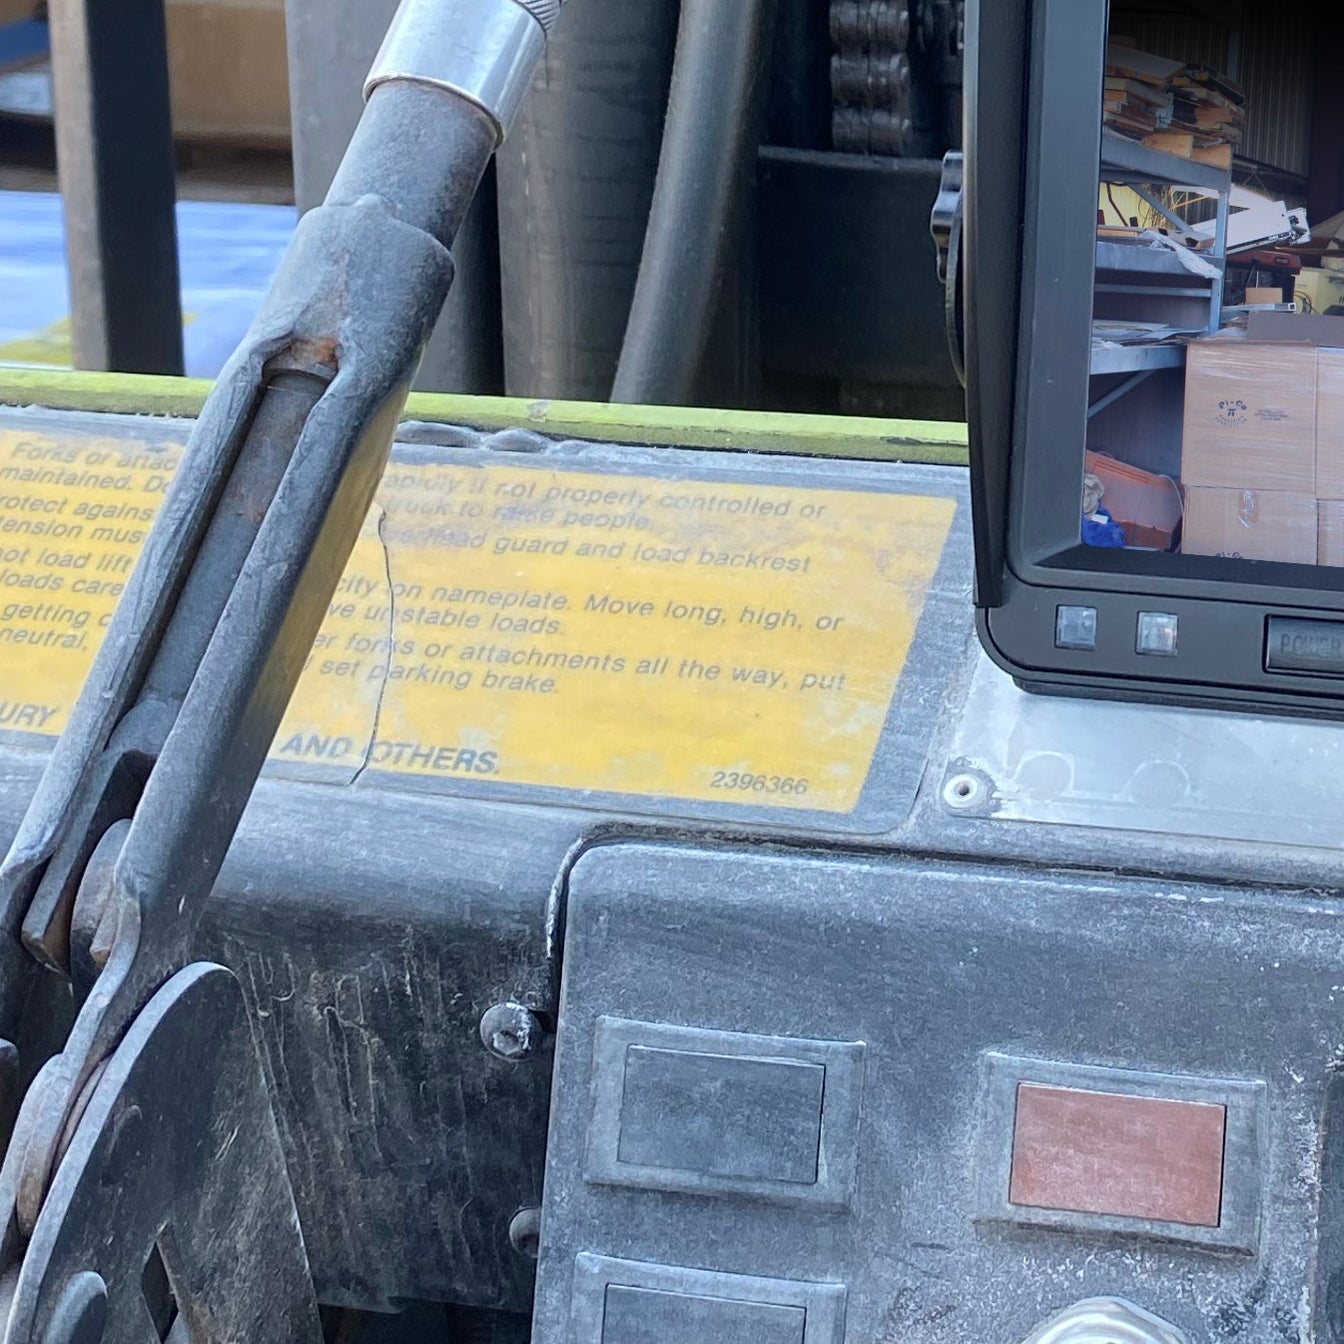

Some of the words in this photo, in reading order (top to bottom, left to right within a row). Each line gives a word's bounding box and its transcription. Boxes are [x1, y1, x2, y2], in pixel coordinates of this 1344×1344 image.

[0, 465, 133, 492] maintained.
[459, 501, 484, 519] to
[85, 451, 112, 465] or
[542, 485, 652, 508] properly
[659, 493, 791, 517] controlled
[800, 503, 827, 519] or
[0, 495, 68, 515] rotect
[73, 501, 154, 521] agains
[494, 534, 569, 555] guard
[575, 540, 626, 560] and
[632, 543, 691, 564] load
[697, 547, 812, 573] backrest
[89, 526, 147, 544] mus
[35, 549, 92, 570] load
[432, 585, 573, 611] nameplate.
[584, 593, 655, 618] Move
[664, 600, 728, 627] long,
[739, 605, 804, 632] high,
[815, 613, 845, 632] or
[71, 579, 124, 598] care
[0, 626, 88, 651] neutral.
[320, 658, 360, 678] set
[1, 603, 91, 628] getting
[424, 642, 452, 657] or
[460, 645, 627, 673] attachments
[635, 655, 669, 676] all
[679, 659, 721, 681] the
[732, 666, 788, 689] way,
[800, 670, 848, 692] put
[0, 700, 57, 727] URY
[281, 733, 353, 759] AND
[365, 740, 501, 775] OTHERS.
[710, 771, 809, 794] 2396366
